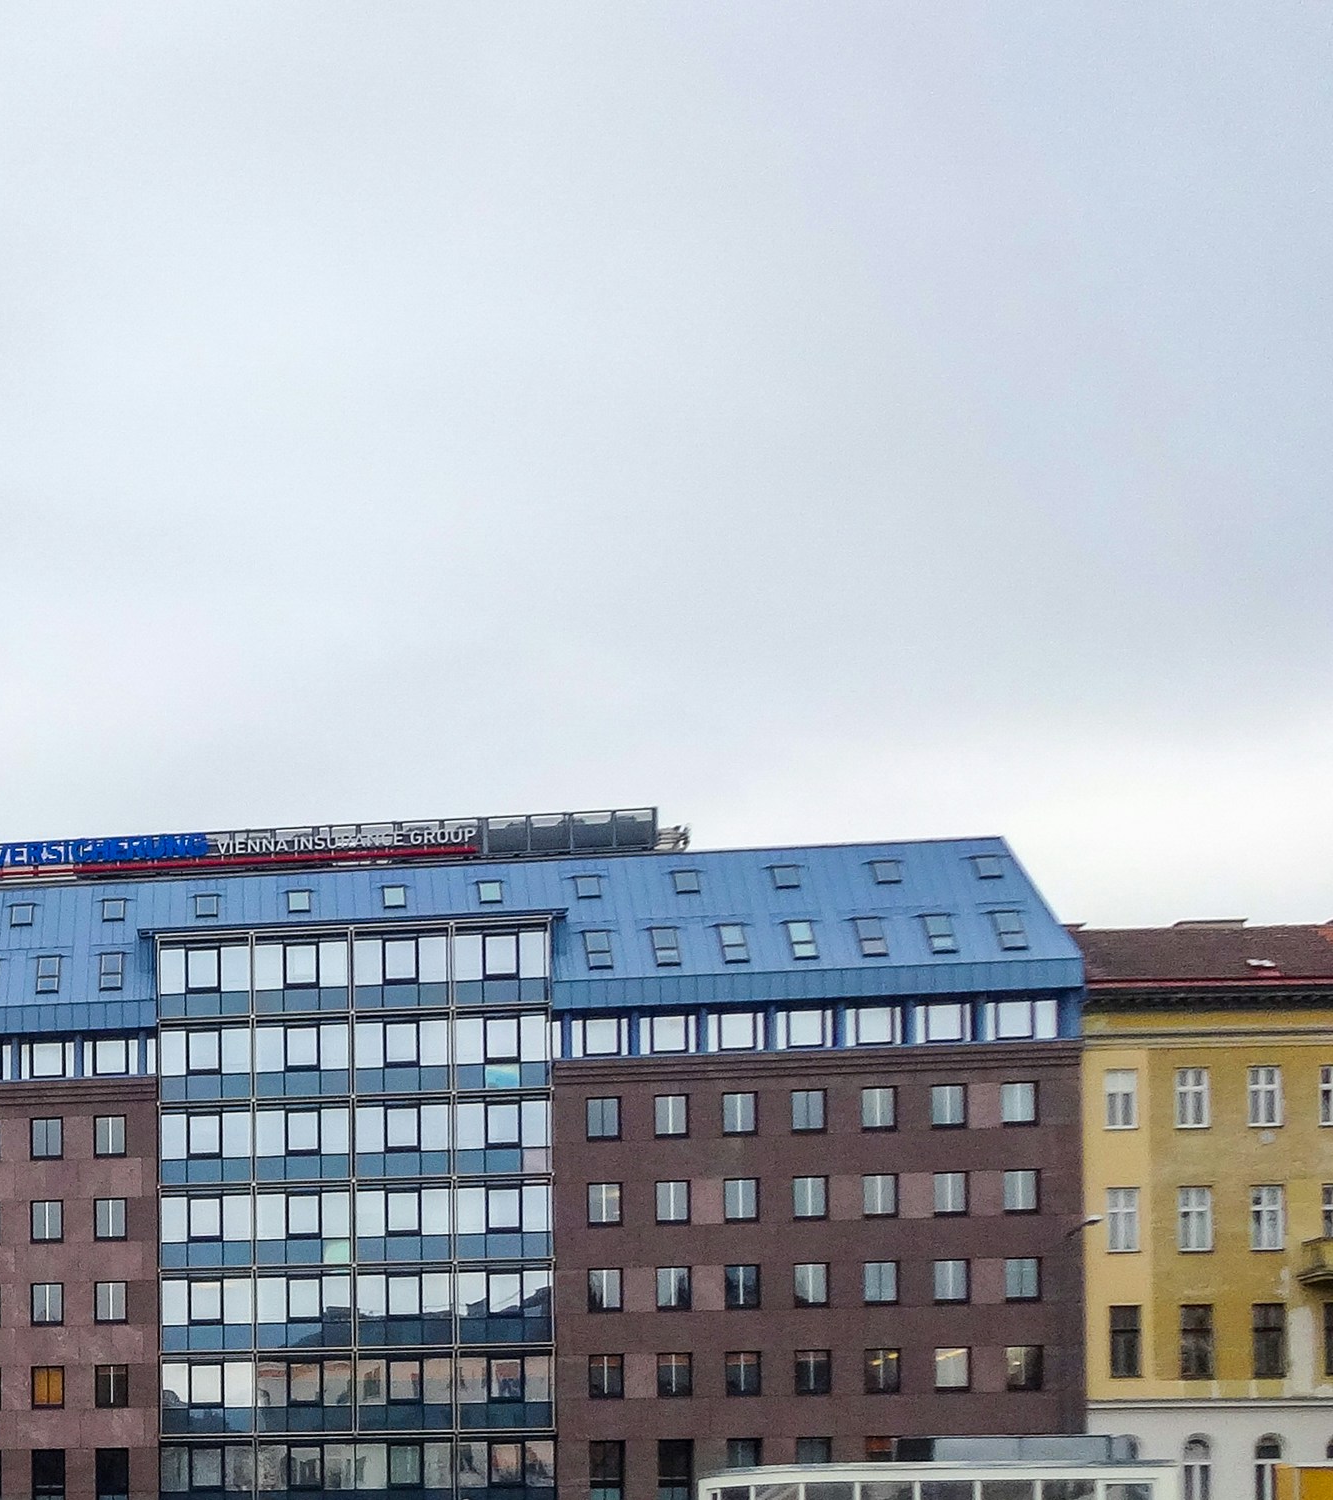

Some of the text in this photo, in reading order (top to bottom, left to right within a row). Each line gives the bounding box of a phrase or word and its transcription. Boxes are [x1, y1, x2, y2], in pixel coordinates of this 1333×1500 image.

[217, 828, 476, 854] VIENNA INSURANCE GROUP
